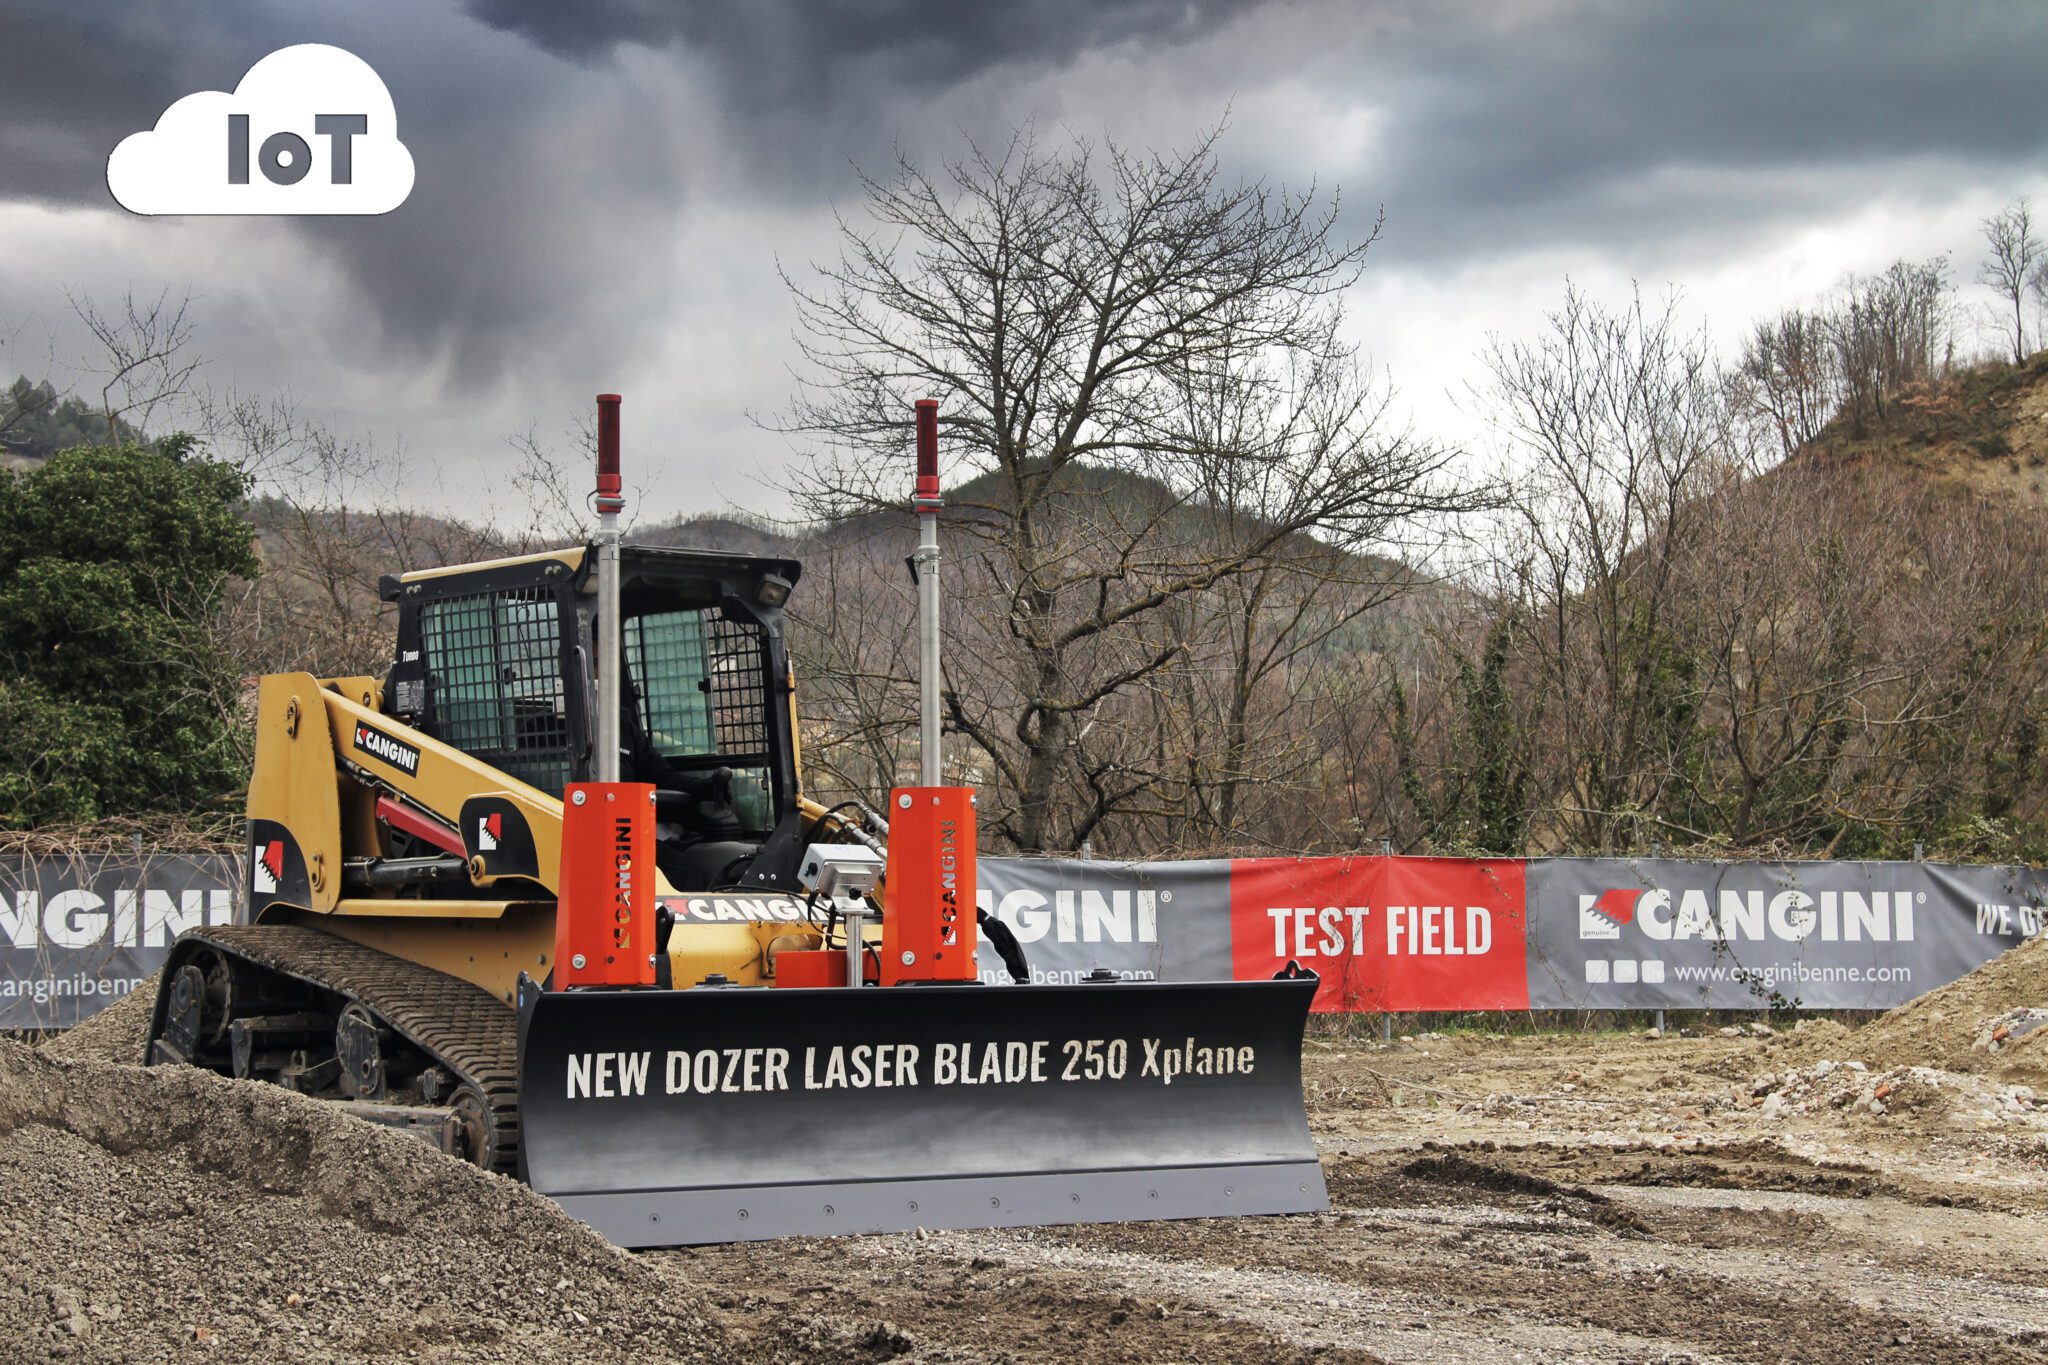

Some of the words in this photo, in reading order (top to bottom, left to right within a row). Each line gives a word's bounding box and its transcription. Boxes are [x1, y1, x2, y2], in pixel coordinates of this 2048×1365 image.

[365, 731, 416, 770] CANGINI
[614, 817, 632, 924] CANGINI
[940, 820, 957, 922] CANGINI
[1266, 906, 1370, 957] TEST
[1386, 906, 1492, 956] FIELD
[1976, 903, 2012, 935] WE
[567, 1051, 651, 1098] NEW
[665, 1047, 789, 1094] DOZER
[805, 1044, 919, 1090] LASER
[934, 1041, 1049, 1085] BLADE
[1061, 1039, 1128, 1080] 250
[1141, 1037, 1255, 1085] Xplane
